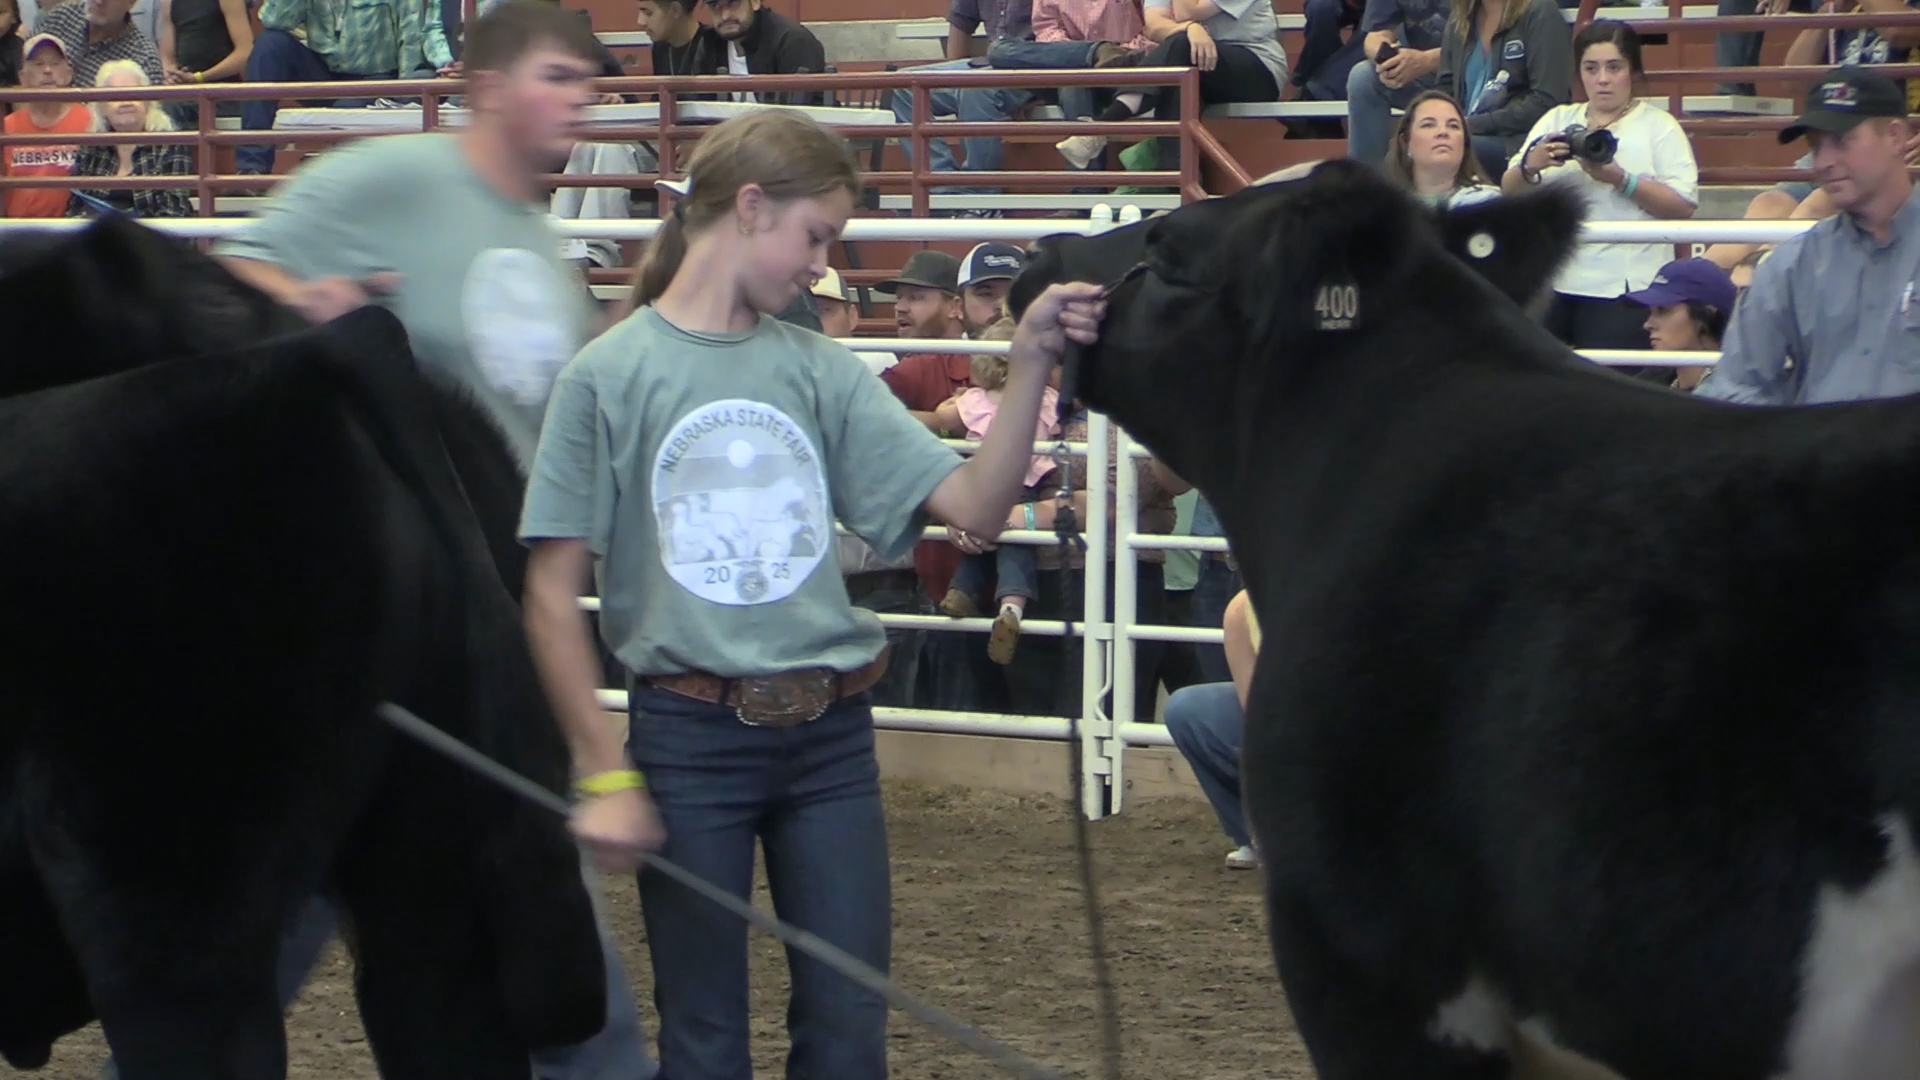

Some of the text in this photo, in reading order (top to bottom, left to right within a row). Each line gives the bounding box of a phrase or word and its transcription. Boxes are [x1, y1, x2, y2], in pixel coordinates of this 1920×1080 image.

[13, 150, 78, 164] NEBRASKA
[1314, 286, 1357, 318] 400
[661, 409, 811, 473] NEBRASKA STATE FAIR
[704, 562, 791, 584] 20 25
